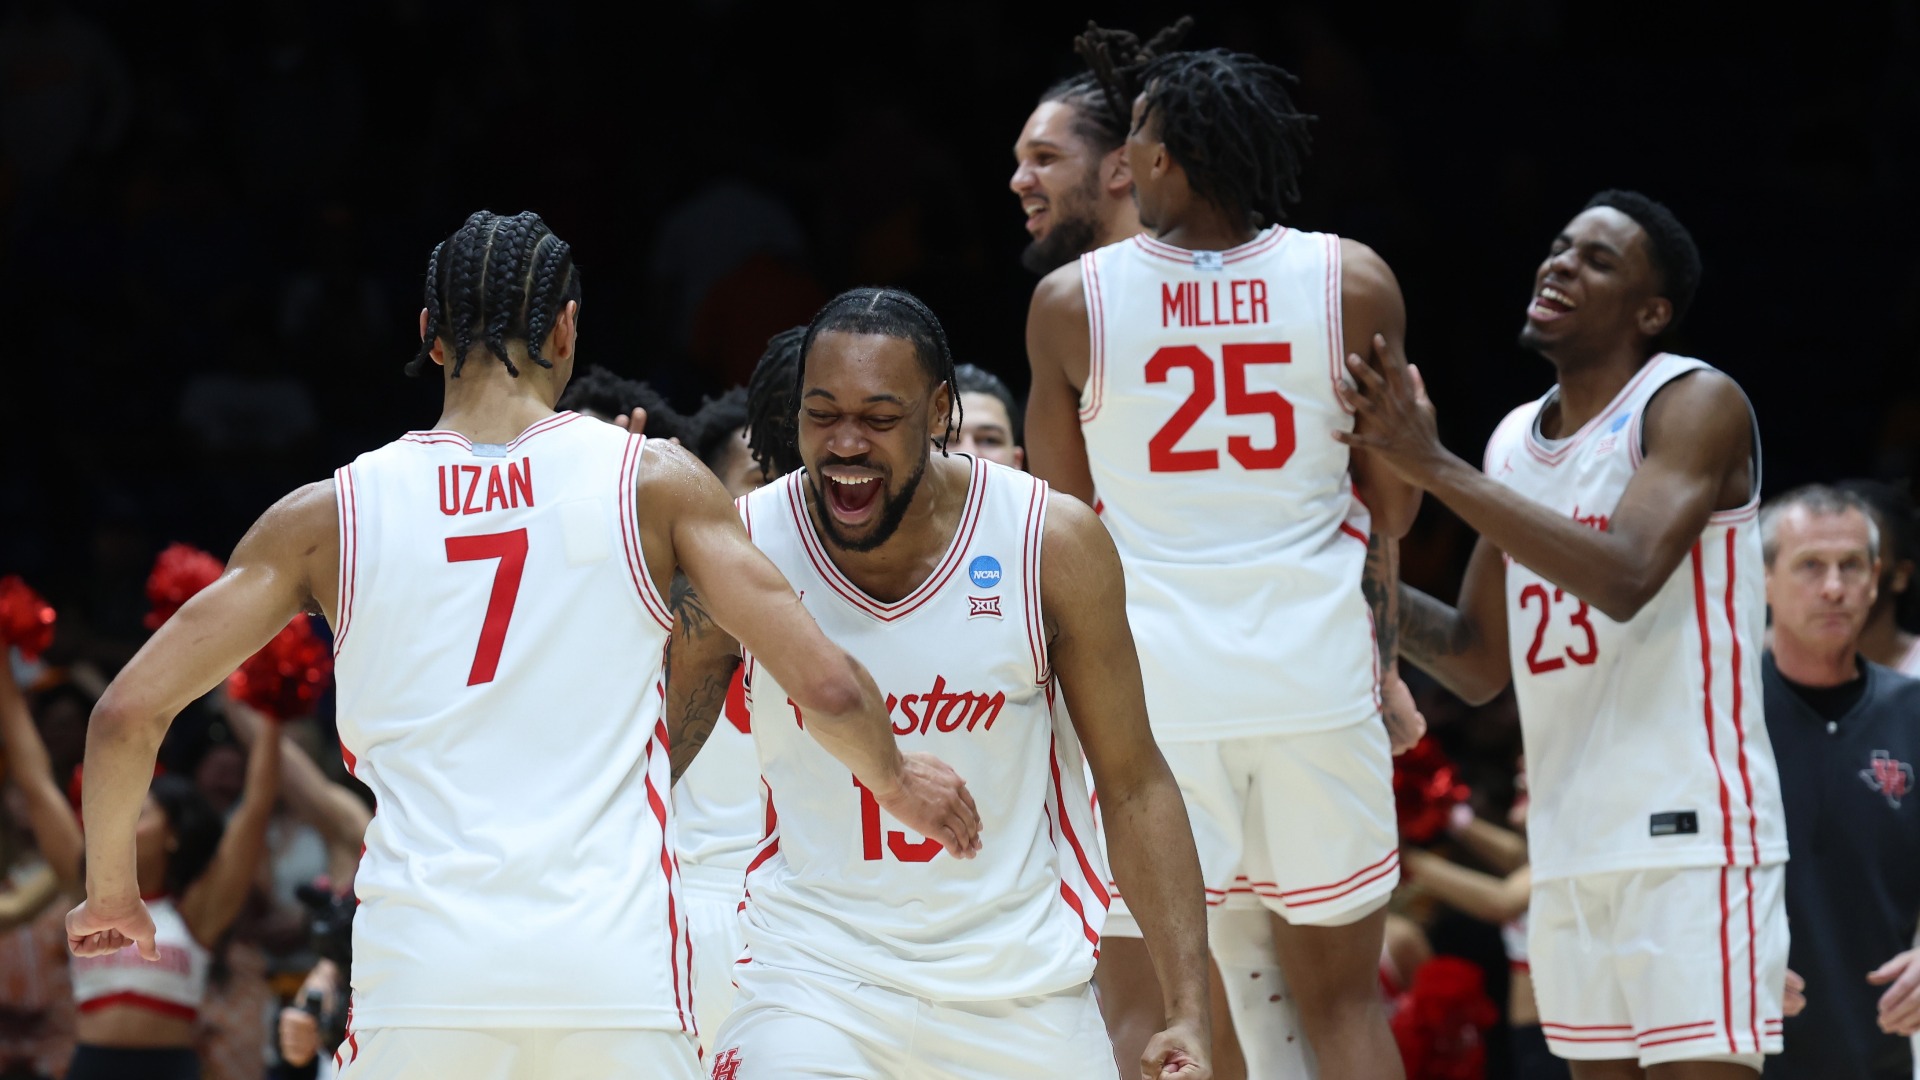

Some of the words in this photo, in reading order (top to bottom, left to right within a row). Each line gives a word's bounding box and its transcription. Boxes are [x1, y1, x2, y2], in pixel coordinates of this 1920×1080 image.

[1162, 279, 1269, 327] MILLER
[1145, 342, 1296, 472] 25
[438, 457, 534, 516] UZAN
[973, 570, 1000, 579] NCAA
[444, 527, 529, 687] 7
[1520, 584, 1599, 675] 23
[787, 674, 1006, 736] ston
